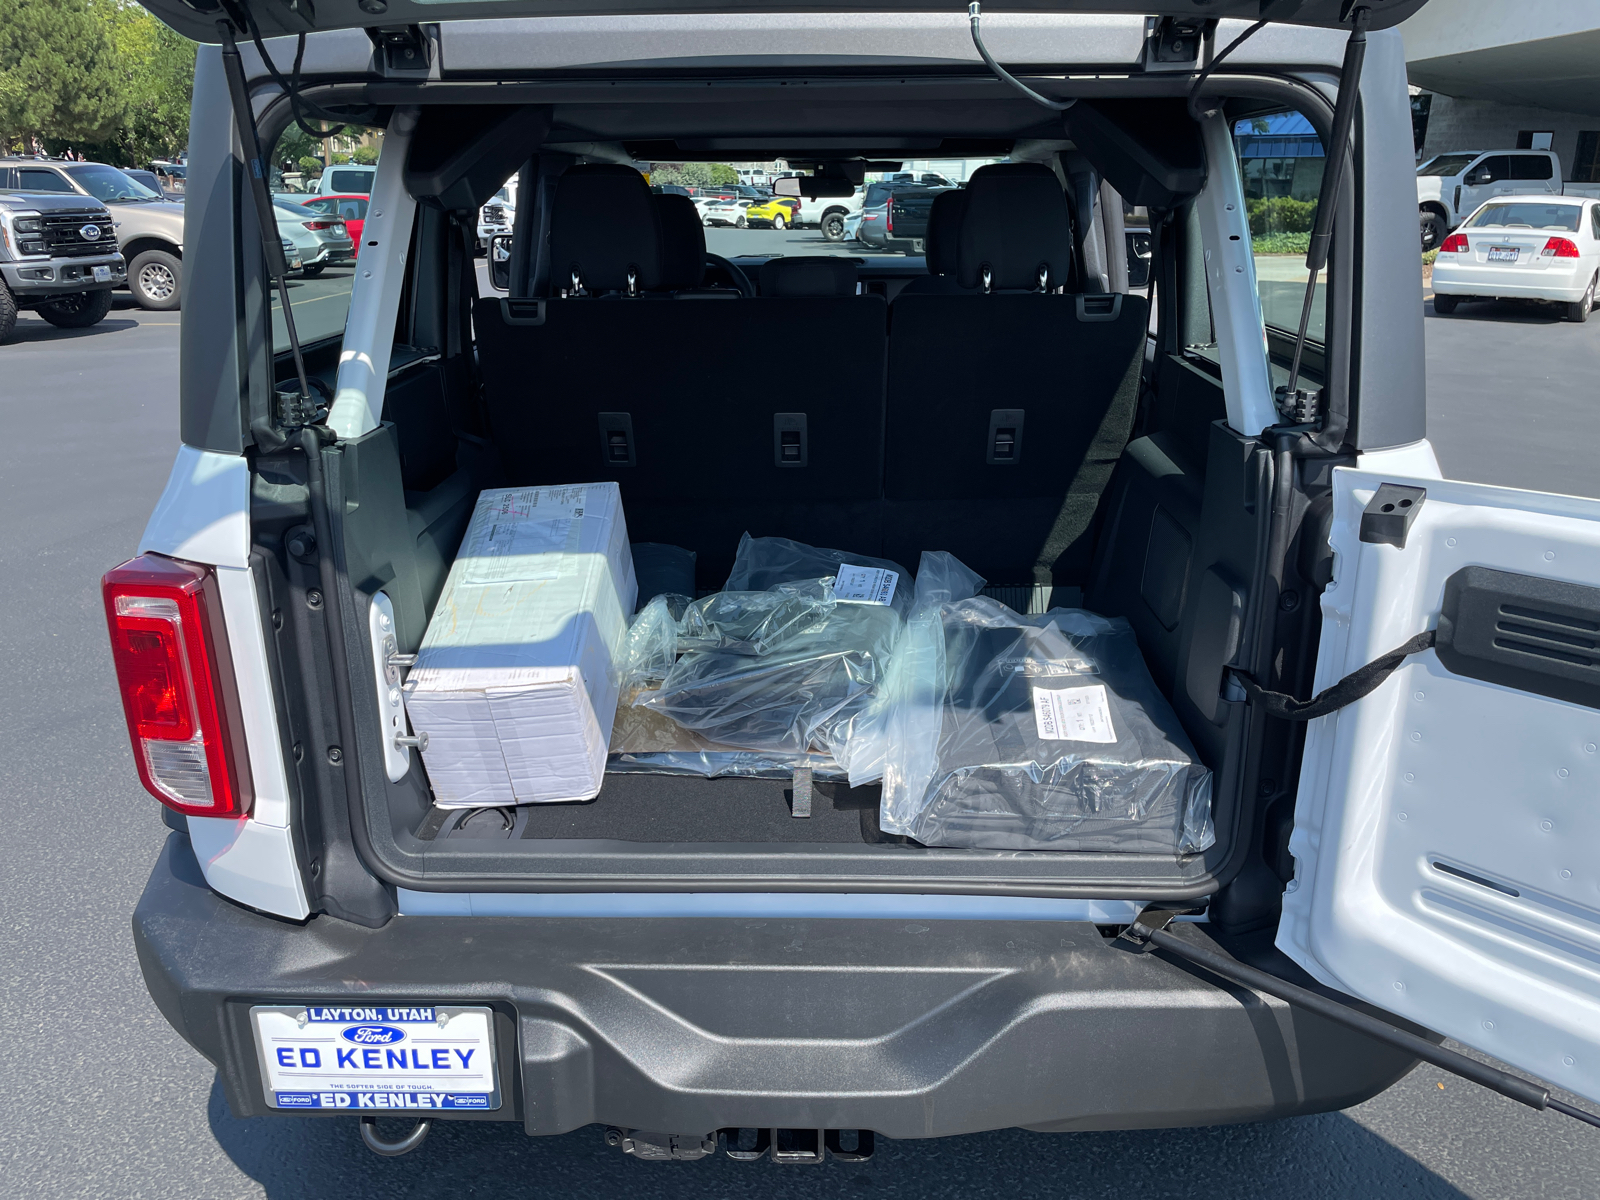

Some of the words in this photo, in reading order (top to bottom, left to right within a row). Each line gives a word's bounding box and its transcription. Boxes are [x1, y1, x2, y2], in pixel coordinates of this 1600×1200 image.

[310, 1008, 382, 1022] LAYTON,
[387, 1008, 432, 1020] UTAH
[354, 1028, 393, 1043] Ford
[276, 1047, 322, 1068] ED
[336, 1048, 476, 1069] KENLEY
[320, 1093, 350, 1107] ED
[358, 1093, 446, 1108] KENLEY
